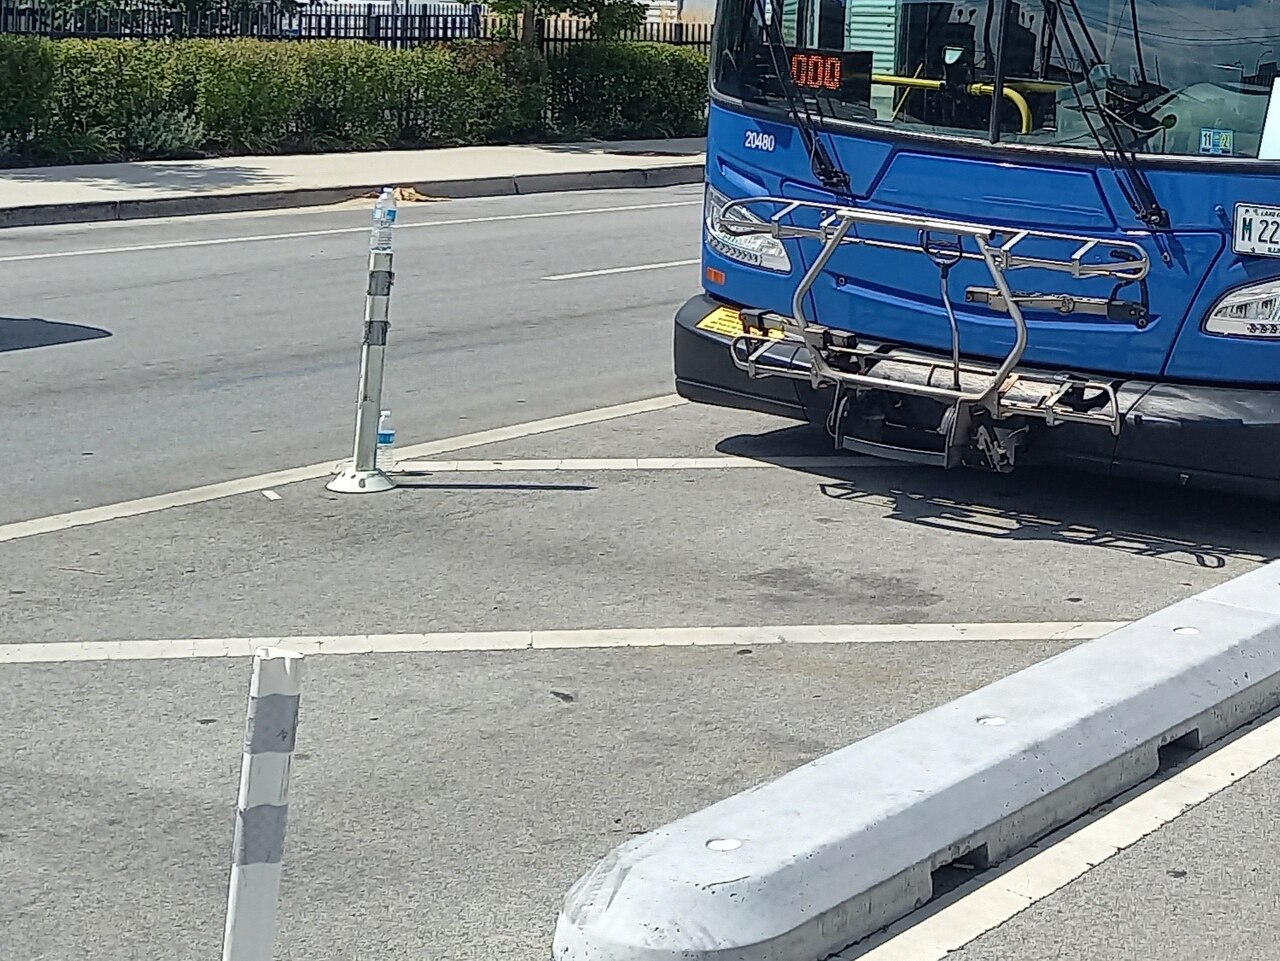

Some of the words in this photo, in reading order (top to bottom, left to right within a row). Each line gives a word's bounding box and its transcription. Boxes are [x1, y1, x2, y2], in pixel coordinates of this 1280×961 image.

[791, 53, 843, 90] 000
[744, 130, 775, 152] 20480
[1203, 132, 1212, 147] 11
[1241, 217, 1253, 242] M
